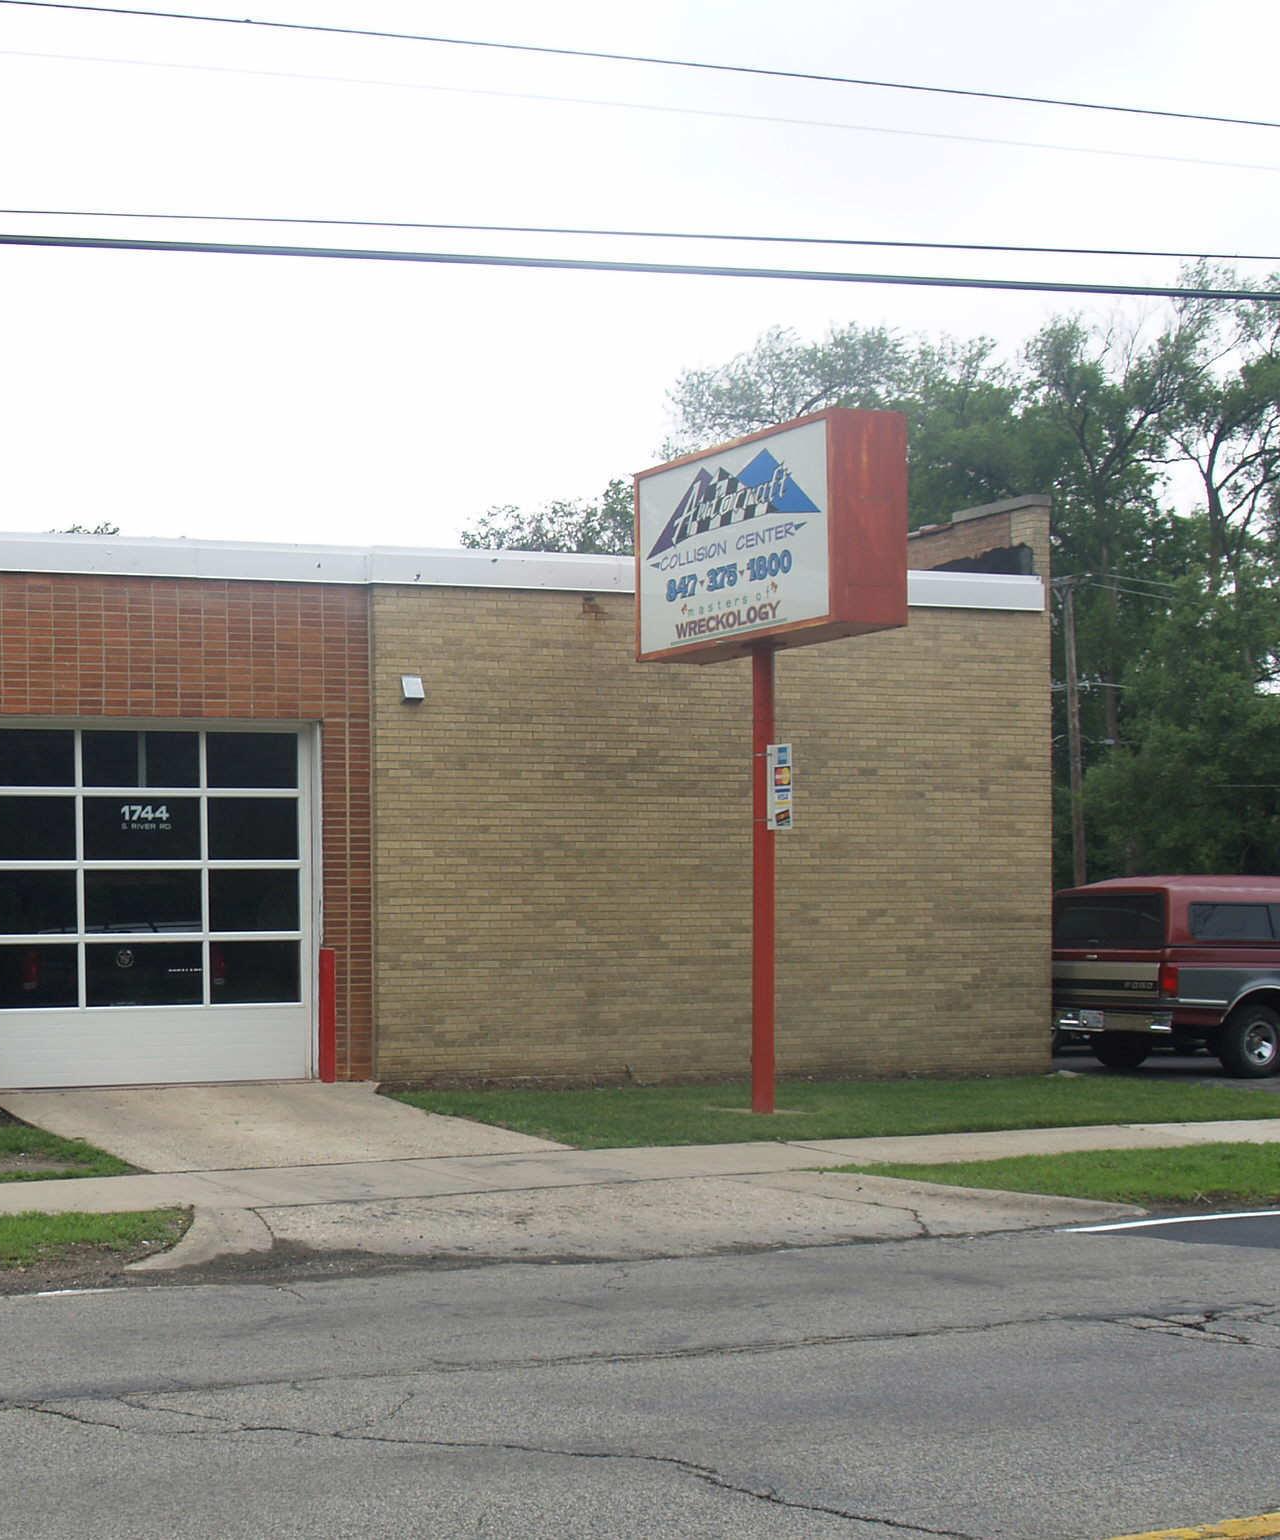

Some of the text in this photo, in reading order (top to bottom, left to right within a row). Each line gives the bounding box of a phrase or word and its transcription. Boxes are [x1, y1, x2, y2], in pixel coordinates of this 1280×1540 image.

[672, 460, 792, 547] Autocraft
[661, 522, 795, 571] COLLISION CENTER
[675, 600, 781, 640] WRECKOLOGY
[687, 595, 748, 617] masters
[120, 804, 170, 821] 1744
